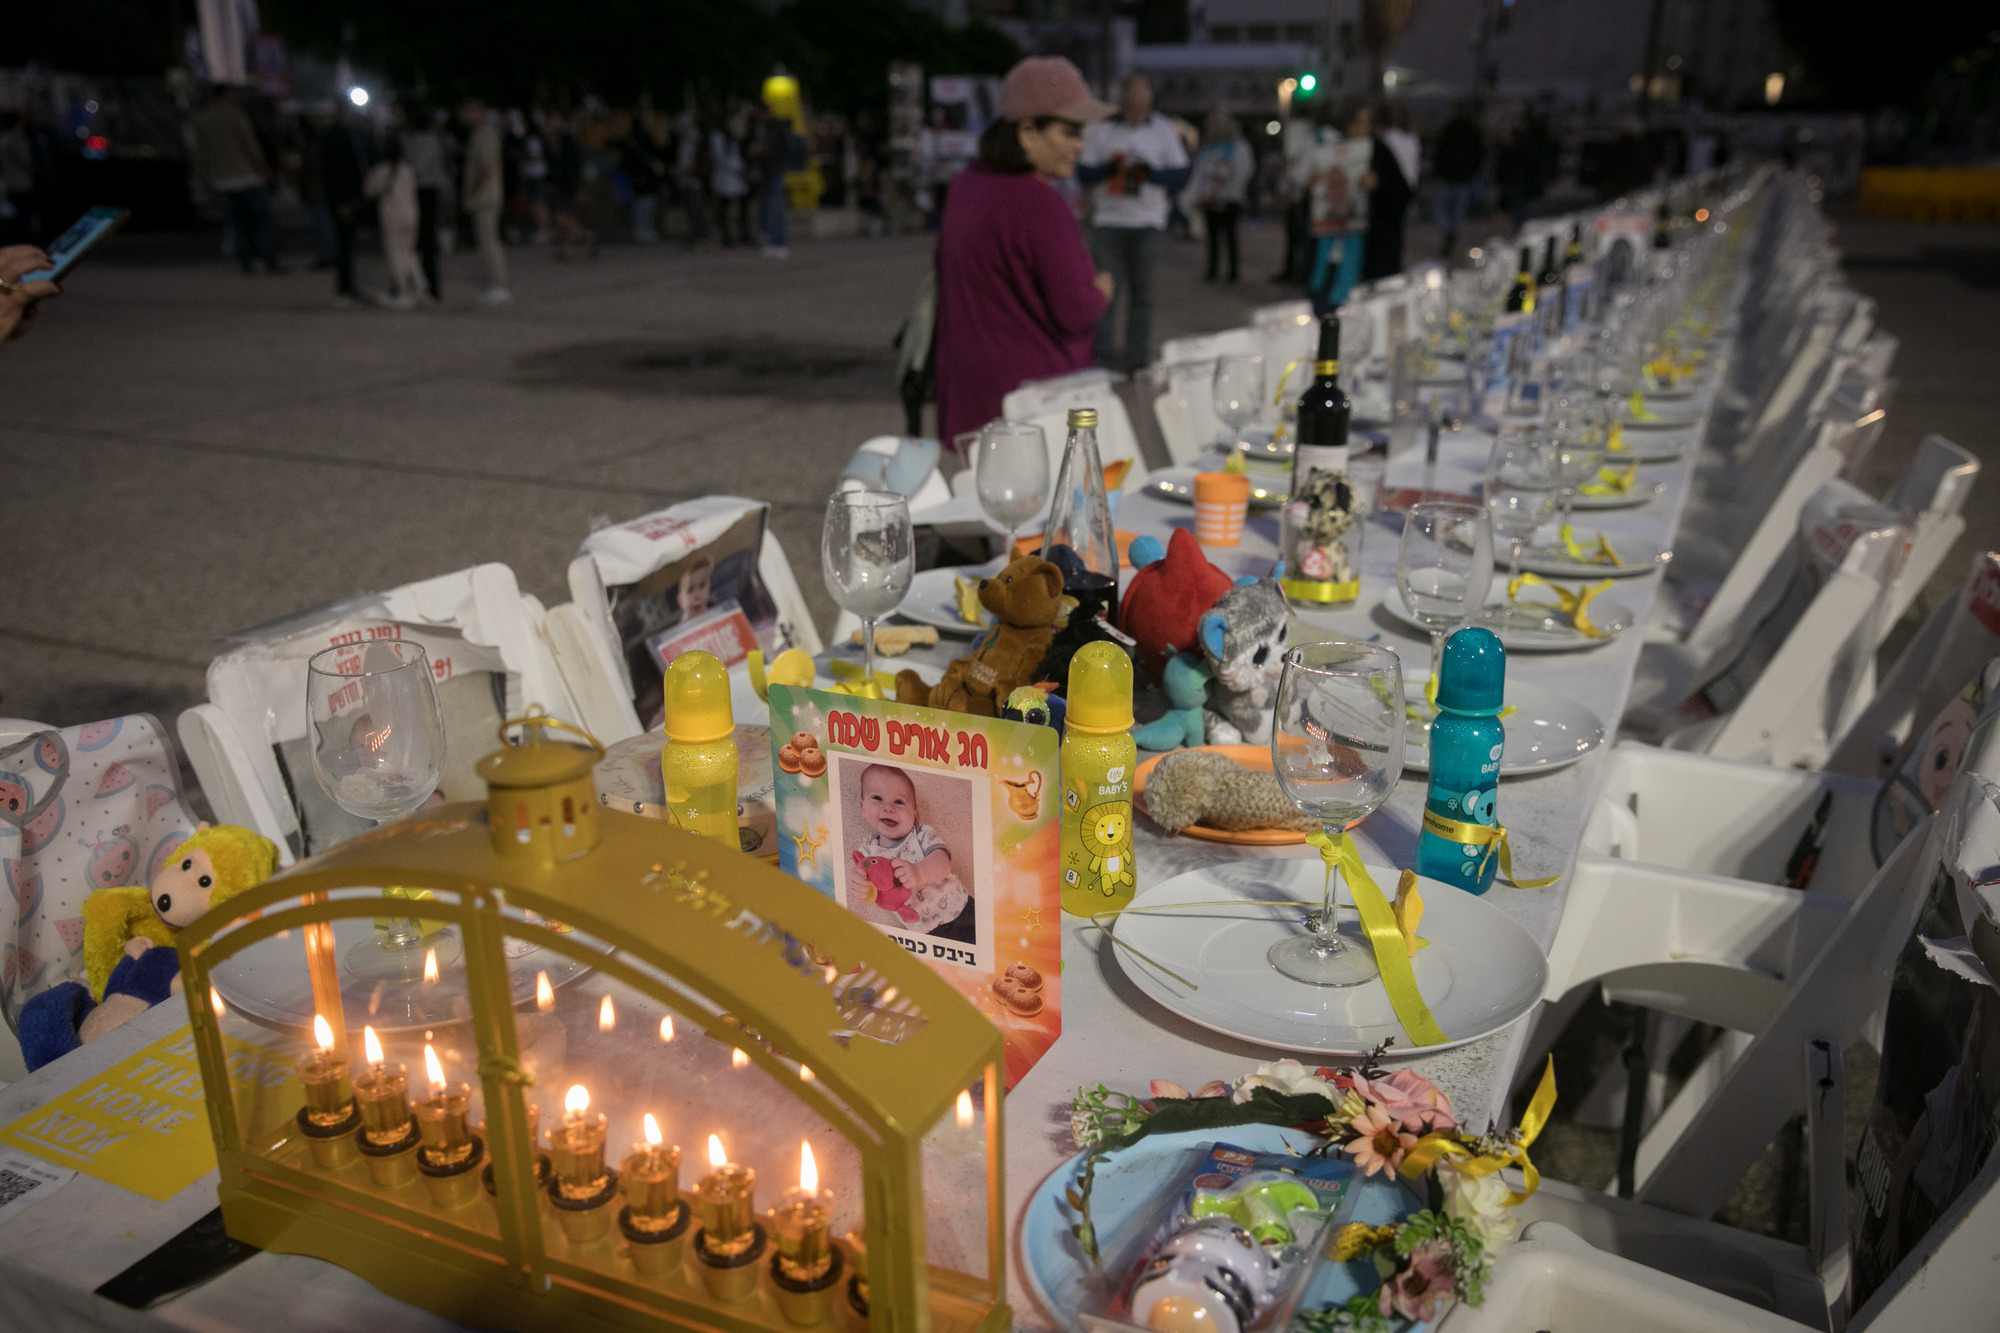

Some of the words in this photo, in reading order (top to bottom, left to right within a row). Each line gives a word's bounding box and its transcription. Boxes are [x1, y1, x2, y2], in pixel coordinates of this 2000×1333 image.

[828, 710, 880, 751] שמח
[886, 720, 950, 764] אורים
[957, 731, 988, 769] חג
[1068, 794, 1074, 803] A
[1098, 781, 1128, 796] BABY'S
[1068, 872, 1074, 881] B
[932, 944, 977, 966] ביבס
[74, 1083, 196, 1135] HOME
[26, 1110, 130, 1155] NOW
